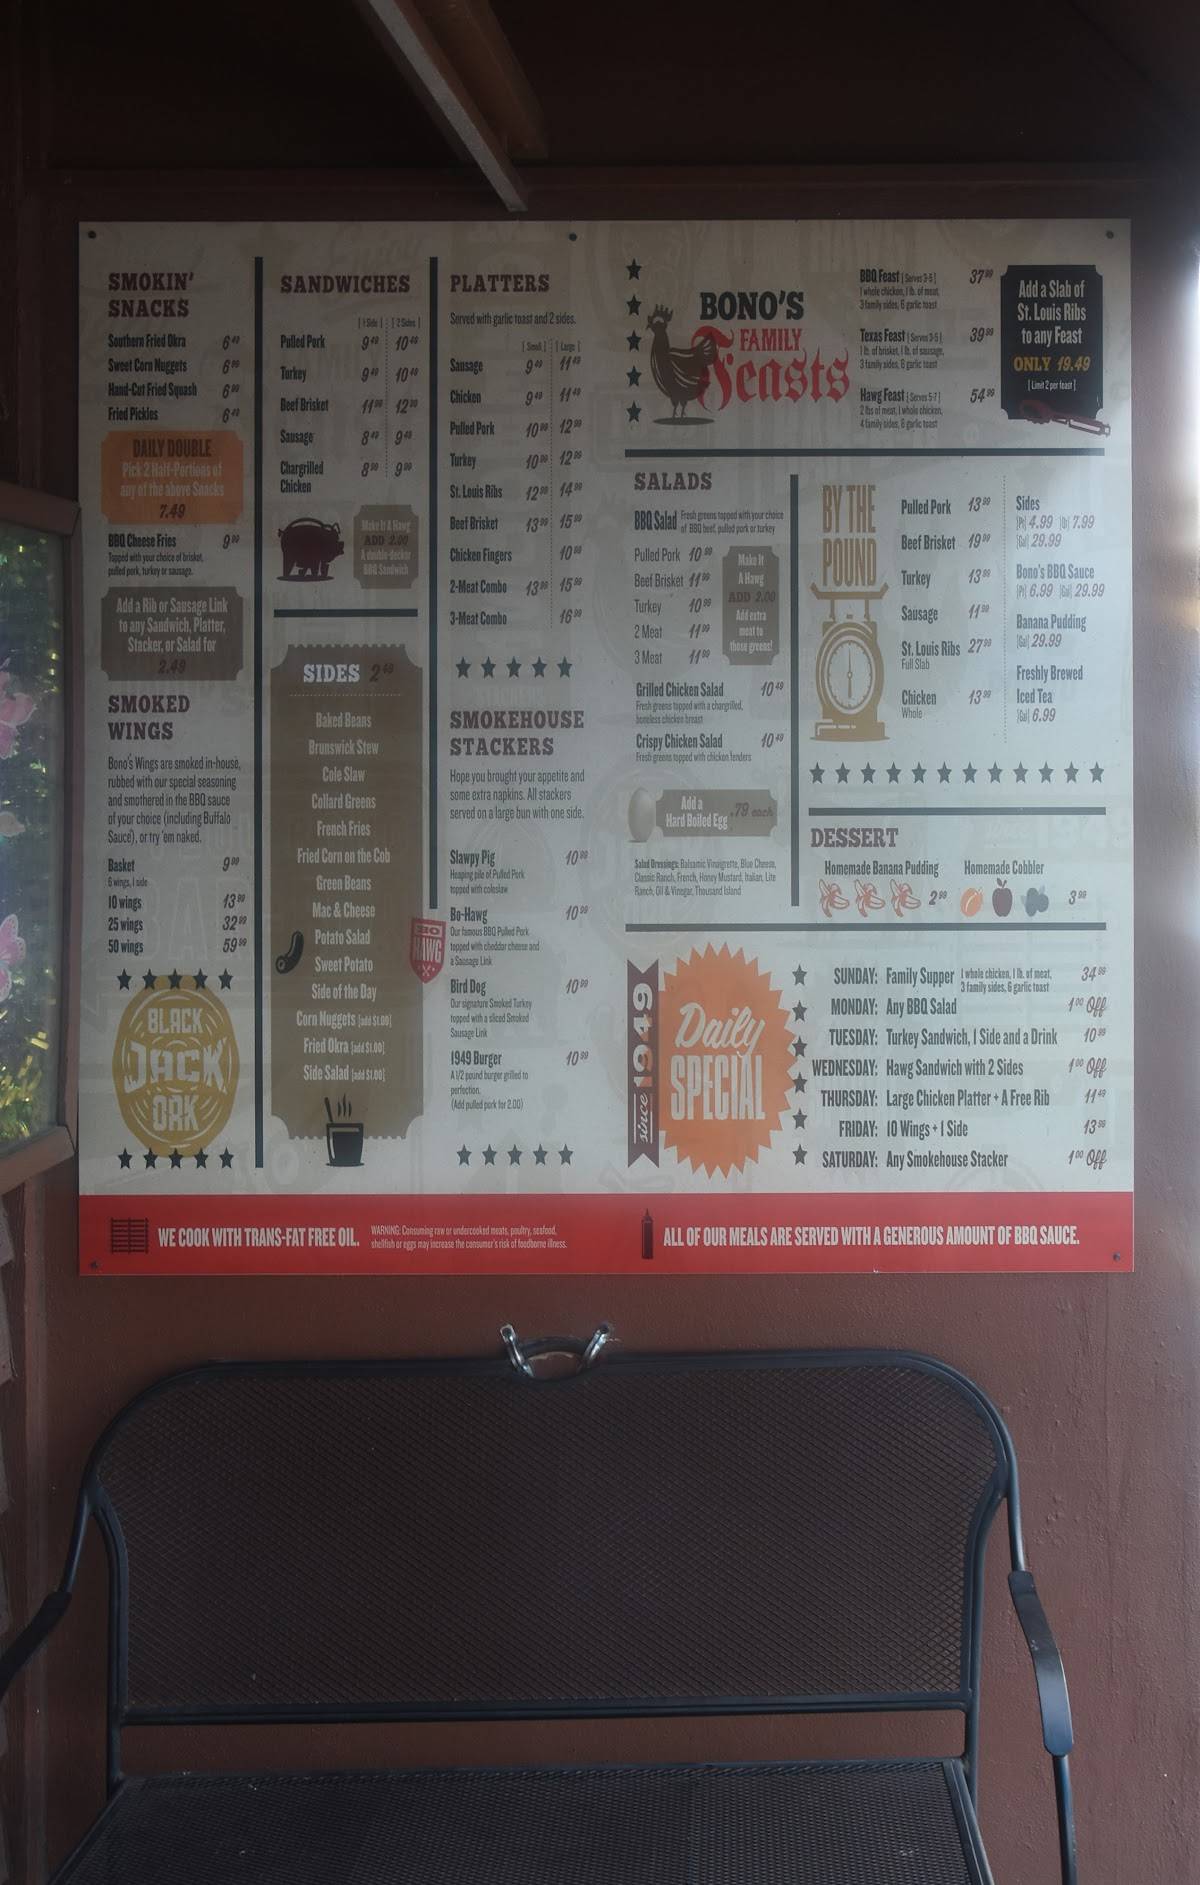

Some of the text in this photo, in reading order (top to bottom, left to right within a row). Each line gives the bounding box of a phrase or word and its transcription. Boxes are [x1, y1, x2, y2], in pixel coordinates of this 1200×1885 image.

[108, 272, 194, 291] SMOKIN'
[280, 275, 410, 293] SANDWICHES
[450, 274, 549, 292] PLATTERS
[1019, 280, 1085, 297] Add a Slab of
[108, 300, 189, 317] SNACKS
[700, 292, 804, 320] BONO'S
[1017, 303, 1086, 321] St. Louis Ribs
[740, 328, 802, 351] FAMILY
[1022, 327, 1082, 347] to any Feast
[691, 325, 850, 411] Feasts
[1013, 357, 1090, 371] ONLY 19.49
[860, 388, 904, 404] Hawg Feast
[108, 408, 158, 421] Fried Pickles
[634, 472, 712, 490] SALADS
[823, 485, 875, 533] BY THE
[902, 500, 951, 514] Pulled Pork
[1016, 496, 1040, 510] Sides
[634, 510, 677, 531] BBQ Salad
[1029, 515, 1094, 528] 4.99 7.99
[108, 534, 176, 548] BBQ Cheese Fries
[902, 535, 956, 550] Beef Brisket
[1031, 534, 1061, 547] 29.99
[450, 547, 512, 564] Chicken Fingers
[823, 538, 877, 587] POUND
[902, 571, 931, 588] Turkey
[1017, 564, 1094, 578] Bono's BBQ Sauce
[1029, 584, 1105, 596] 6.99 29.99
[634, 599, 661, 615] Turkey
[902, 607, 938, 623] Sausage
[450, 612, 507, 625] 3-Meat Combo
[1017, 614, 1086, 632] Banana Pudding
[902, 641, 960, 656] St. Louis Ribs
[1032, 634, 1061, 647] 29.99
[902, 659, 929, 669] Full Slab
[303, 664, 360, 682] SIDES
[1017, 665, 1083, 683] Freshly Brewed
[636, 682, 723, 696] Grilled Chicken Salad
[902, 690, 936, 705] Chicken
[1017, 689, 1052, 703] Iced Tea
[108, 695, 190, 713] SMOKED
[316, 713, 371, 727] Baked Beans
[451, 711, 584, 729] SMOKEHOUSE
[902, 708, 922, 718] Whole
[1033, 708, 1055, 721] 6.99
[108, 722, 173, 740] WINGS
[450, 738, 554, 756] STACKERS
[108, 757, 133, 770] Bono's
[135, 757, 158, 773] Wings
[160, 757, 172, 770] are
[174, 757, 204, 770] smoked
[323, 767, 365, 781] Cole Slaw
[811, 828, 898, 848] DESSERT
[108, 859, 135, 872] Basket
[450, 850, 495, 867] Slawpy Pig
[824, 860, 939, 877] Homemade Banana Pudding
[964, 860, 1044, 875] Homemade Cobbler
[119, 895, 142, 911] wings
[450, 907, 487, 924] Bo-Hawg
[108, 917, 143, 933] 25 wings
[315, 930, 370, 944] Potato Salad
[108, 940, 143, 955] 50 wings
[834, 968, 878, 985] SUNDAY:
[451, 979, 486, 997] Bird Dog
[831, 998, 957, 1018] MONDAY: Any BBQ Salad
[148, 1008, 204, 1034] BLACK
[675, 1002, 765, 1056] Daily
[633, 983, 652, 1088] 1949
[829, 1029, 878, 1046] TUESDAY:
[125, 1038, 228, 1093] JACK
[451, 1052, 502, 1068] 1949 Burger
[813, 1059, 1023, 1079] WEDNESDAY: Hawg Sandwich with 2 Sides
[671, 1055, 765, 1120] SPECIAL
[821, 1089, 878, 1107] THURSDAY:
[839, 1120, 878, 1136] FRIDAY:
[823, 1152, 1008, 1170] SATURDAY: Any Smokehouse Stacker
[158, 1228, 359, 1247] WE COOK WITH TRANS-FAT FREE OIL.
[663, 1227, 1080, 1246] ALL OF OUR MEALS ARE SERVED WITH A GENEROUS AMOUNT OF BBQ SAUCE.
